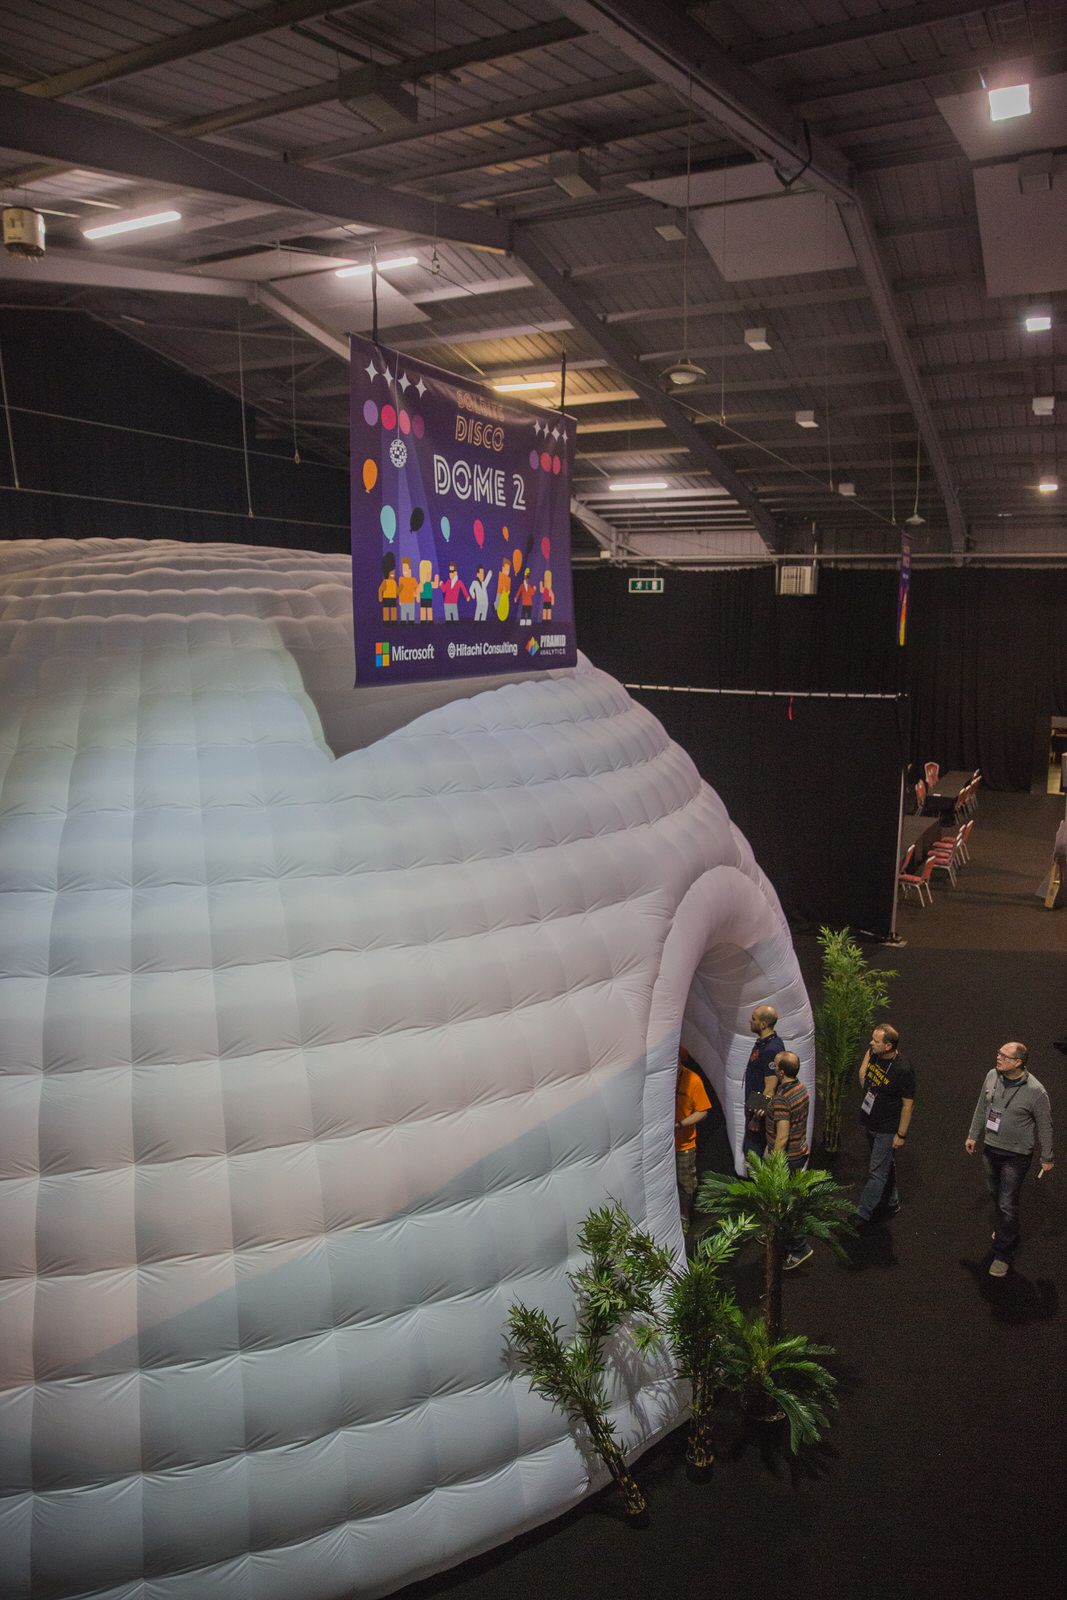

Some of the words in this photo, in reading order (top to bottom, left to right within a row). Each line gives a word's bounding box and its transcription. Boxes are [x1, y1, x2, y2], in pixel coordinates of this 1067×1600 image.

[455, 415, 505, 452] DISCO
[433, 454, 507, 507] DOME
[512, 473, 526, 510] 2
[456, 642, 483, 657] Hitachi
[483, 641, 518, 656] Consulting
[540, 634, 566, 648] PYRAMID
[392, 644, 434, 661] Microsoft
